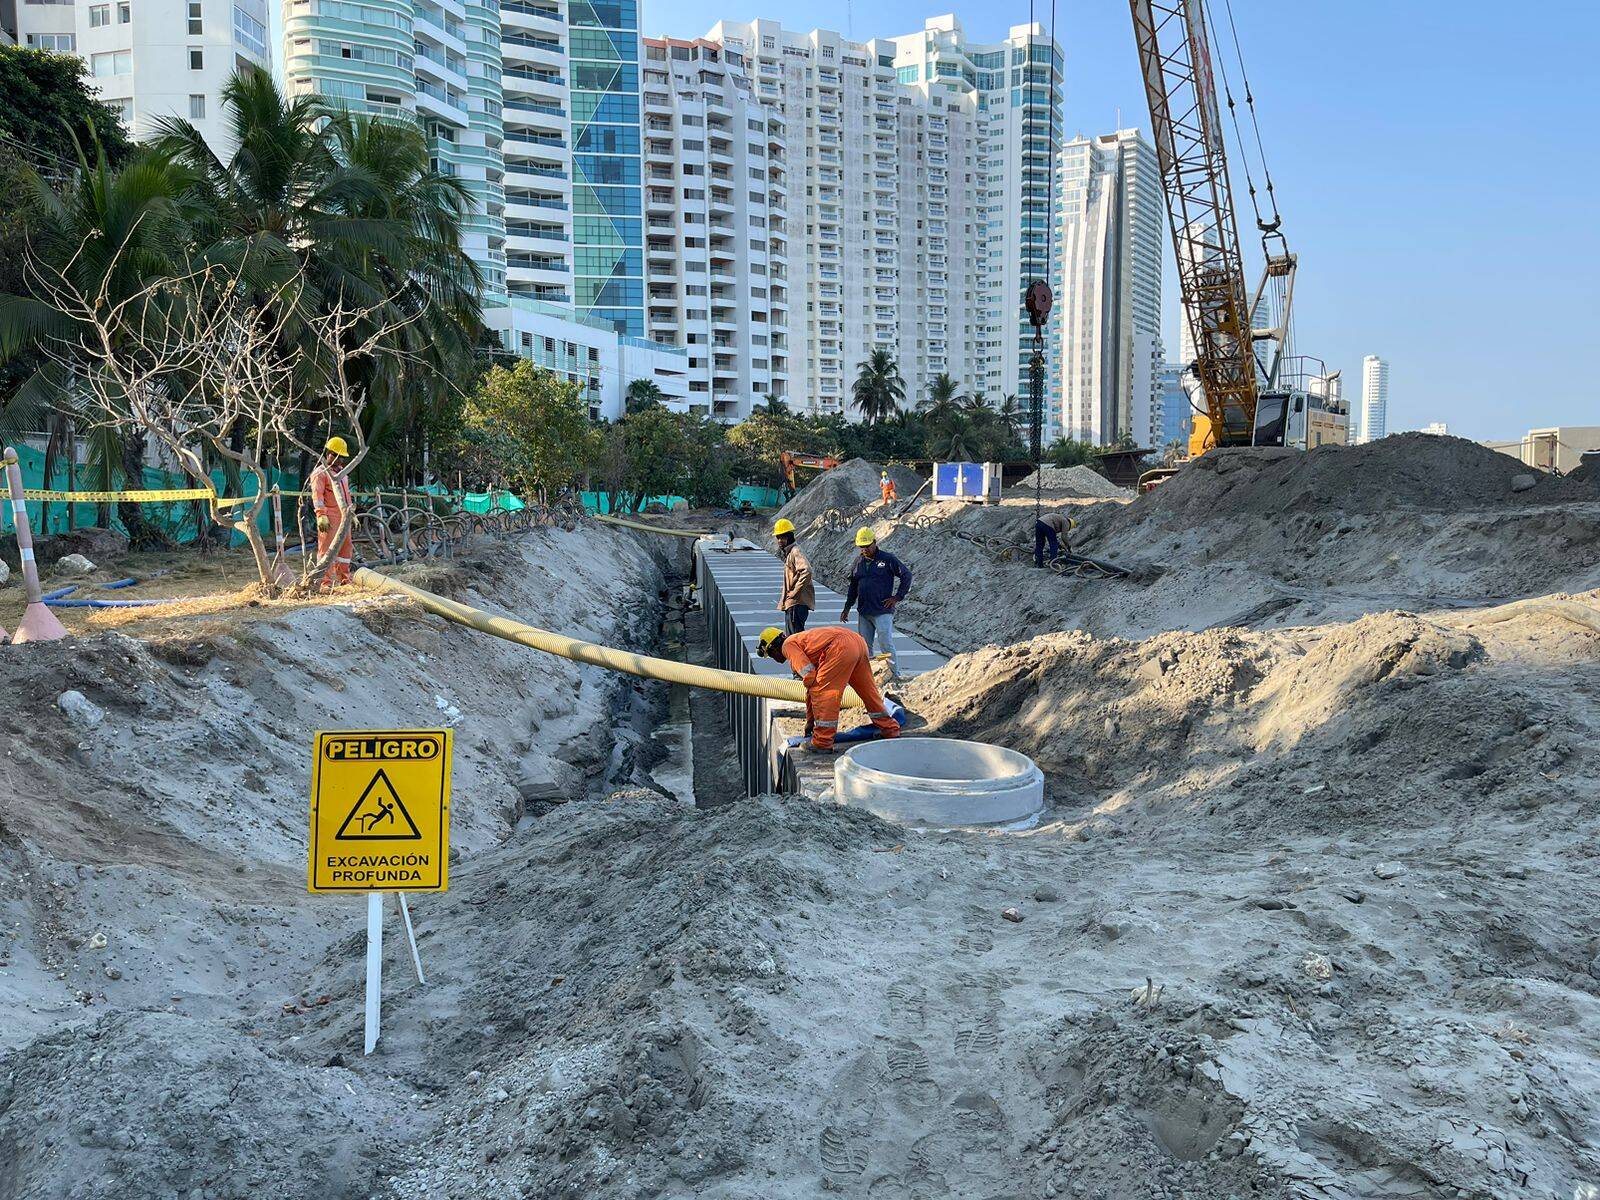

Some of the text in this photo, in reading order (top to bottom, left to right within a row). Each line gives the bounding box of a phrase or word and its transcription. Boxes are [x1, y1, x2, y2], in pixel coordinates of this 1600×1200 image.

[328, 740, 436, 759] PELIGRO
[327, 853, 429, 867] EXCAVACIÓN
[332, 870, 421, 881] PROFUNDA
